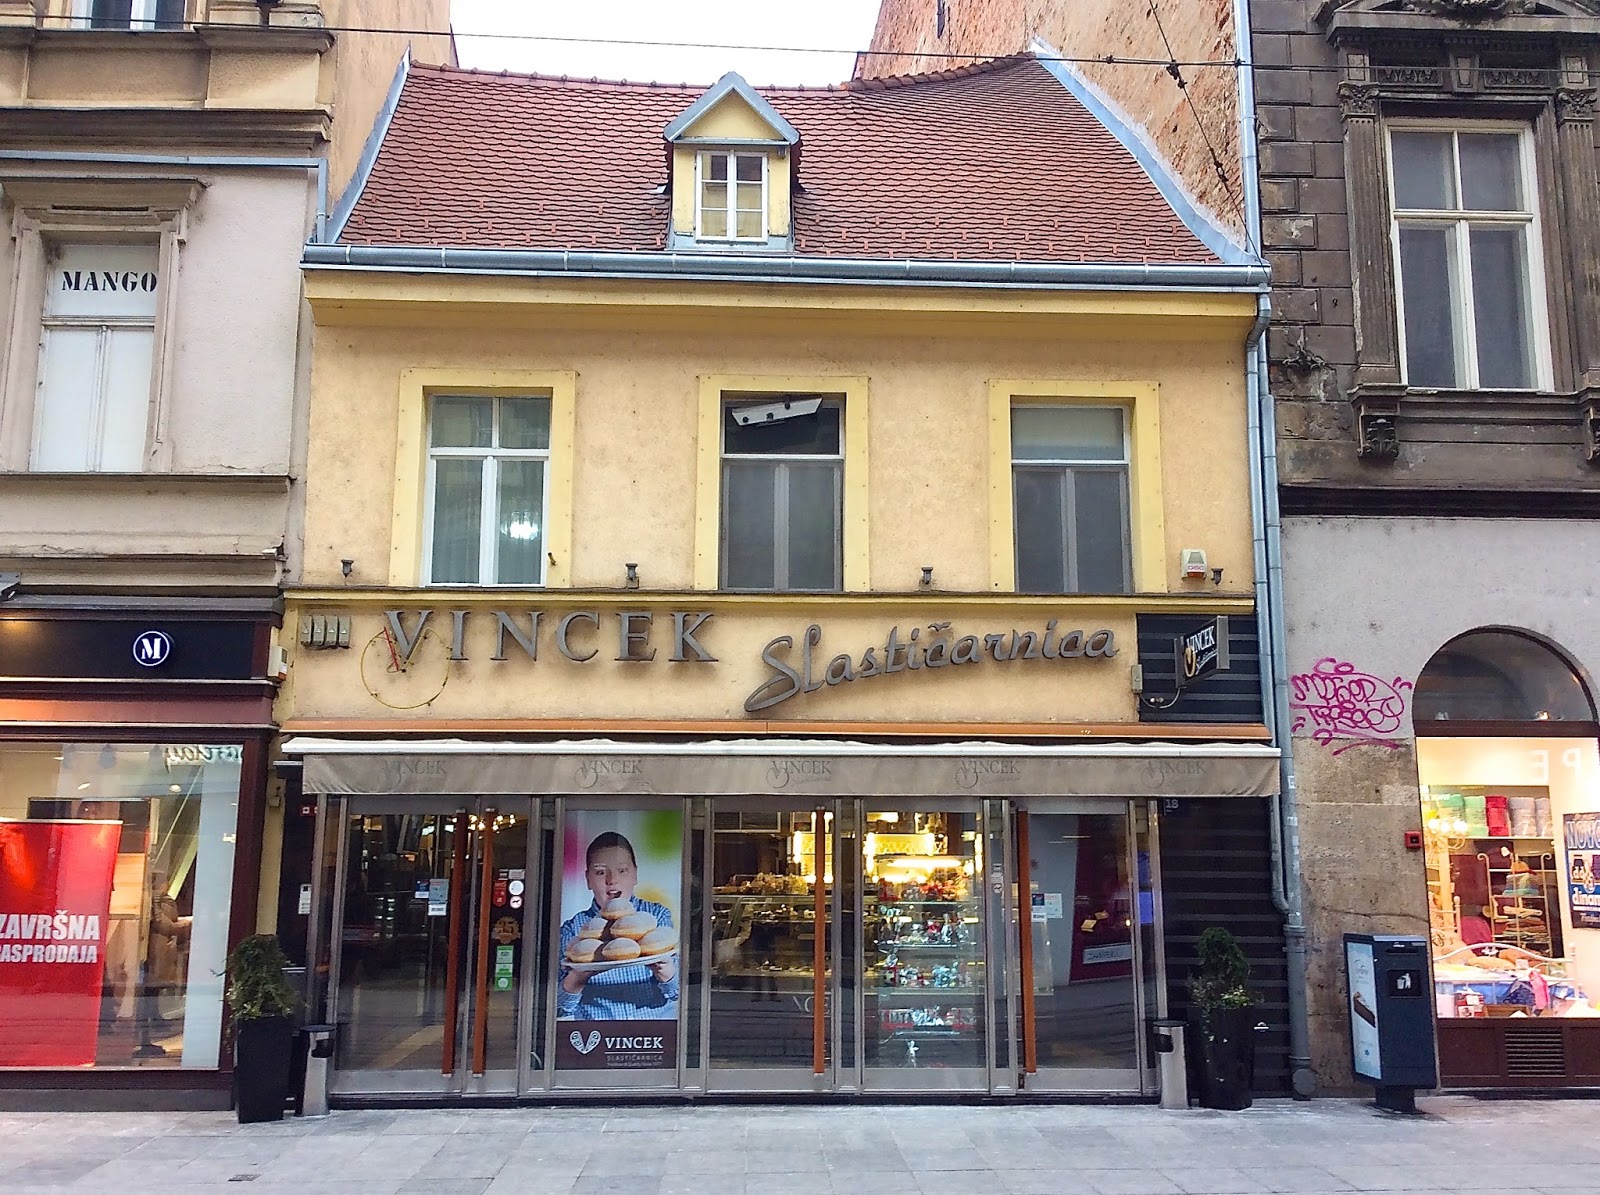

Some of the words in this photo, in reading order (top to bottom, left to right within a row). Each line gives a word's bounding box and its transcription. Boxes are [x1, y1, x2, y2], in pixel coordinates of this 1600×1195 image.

[62, 271, 157, 292] MANGO
[1185, 625, 1215, 658] VINCEK
[384, 610, 719, 662] VINCEK
[744, 619, 1121, 712] Slastičarnica
[577, 760, 644, 779] VINCEK
[769, 760, 832, 779] VINCEK
[958, 760, 1020, 779] VINCEK
[1165, 798, 1180, 809] 18
[0, 944, 98, 963] ASPRODAJA
[604, 1036, 664, 1049] VINCEK
